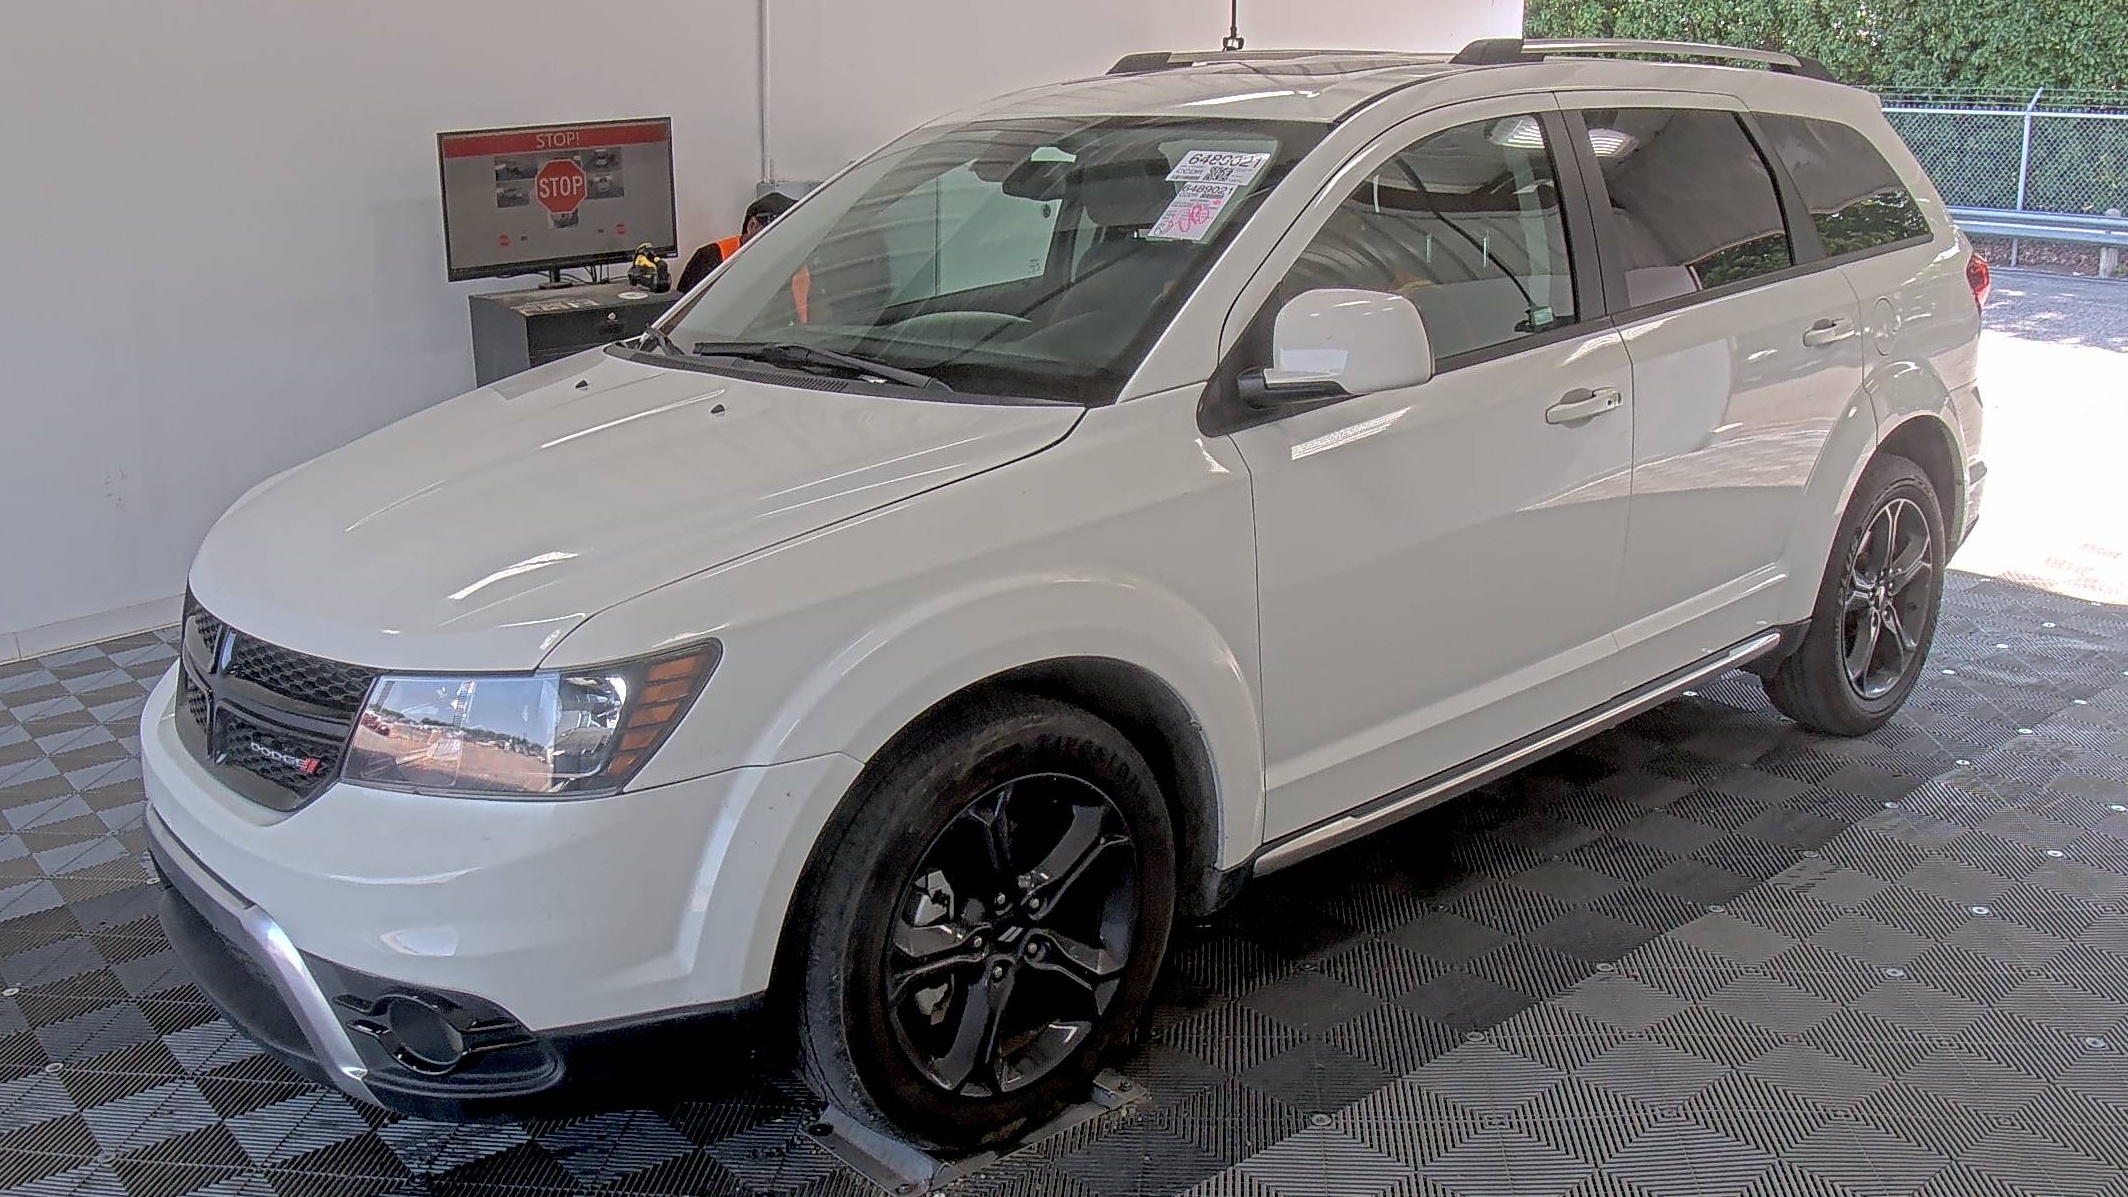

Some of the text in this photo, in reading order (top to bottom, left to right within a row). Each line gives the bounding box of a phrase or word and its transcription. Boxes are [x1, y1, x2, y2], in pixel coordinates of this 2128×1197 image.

[536, 131, 580, 149] STOP!
[1188, 153, 1261, 168] 6489021
[539, 175, 583, 198] STOP
[1182, 184, 1233, 195] 6489021
[250, 742, 306, 768] DODGE
